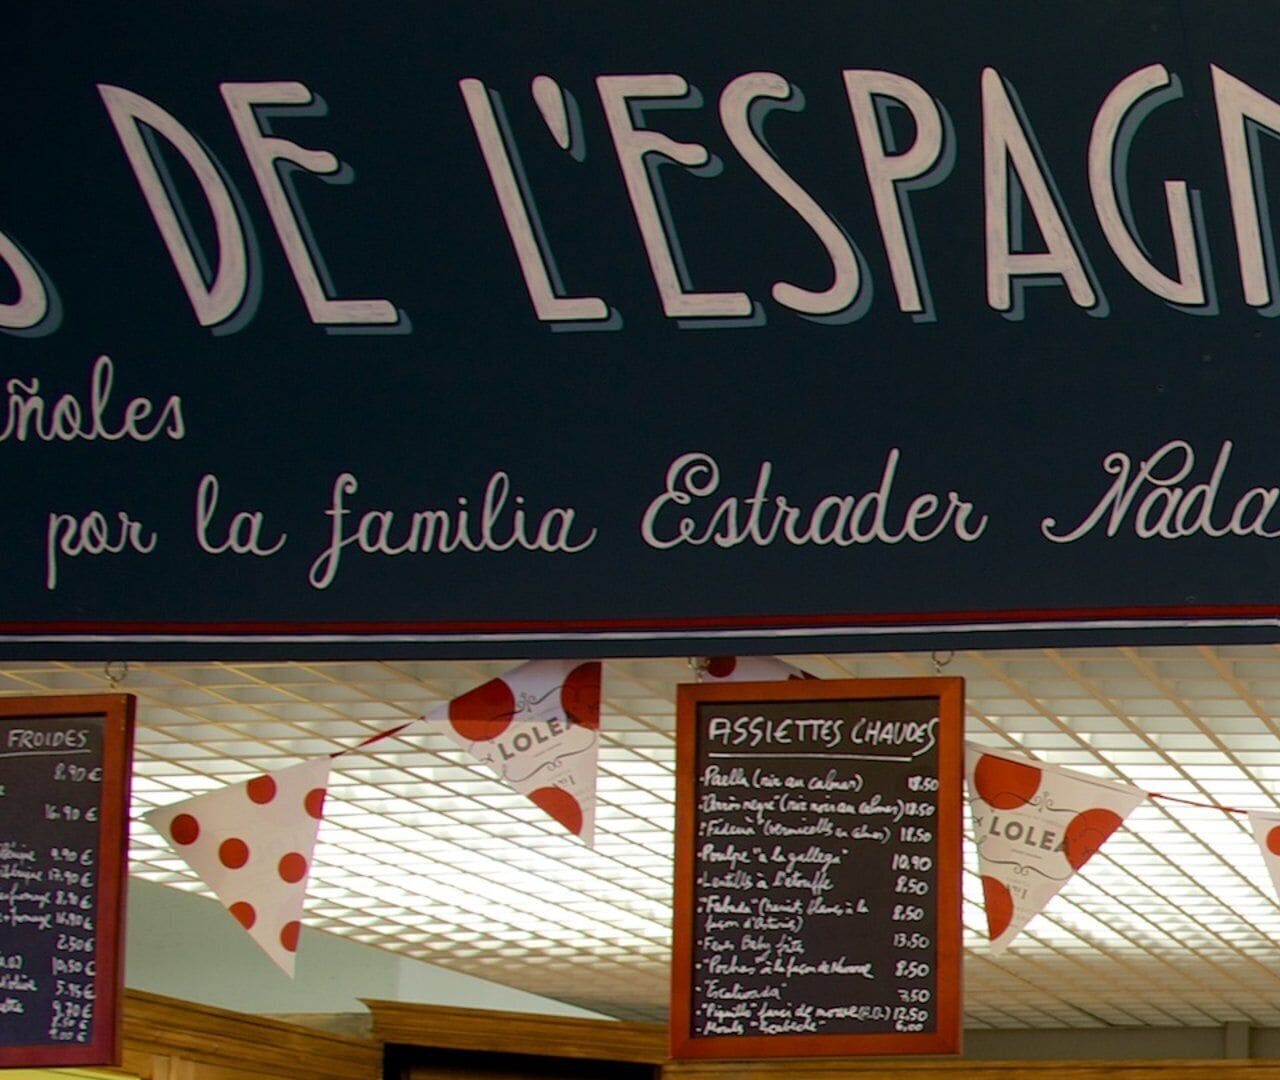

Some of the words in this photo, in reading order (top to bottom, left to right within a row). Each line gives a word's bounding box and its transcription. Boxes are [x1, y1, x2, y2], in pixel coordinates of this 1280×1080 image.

[97, 80, 405, 332] DE
[47, 510, 156, 590] por
[198, 474, 287, 555] la
[310, 471, 597, 589] familia
[642, 448, 987, 547] Estrader
[8, 729, 90, 749] FROIDES
[708, 716, 844, 748] ASSIETTES
[851, 717, 939, 757] CHAUDES
